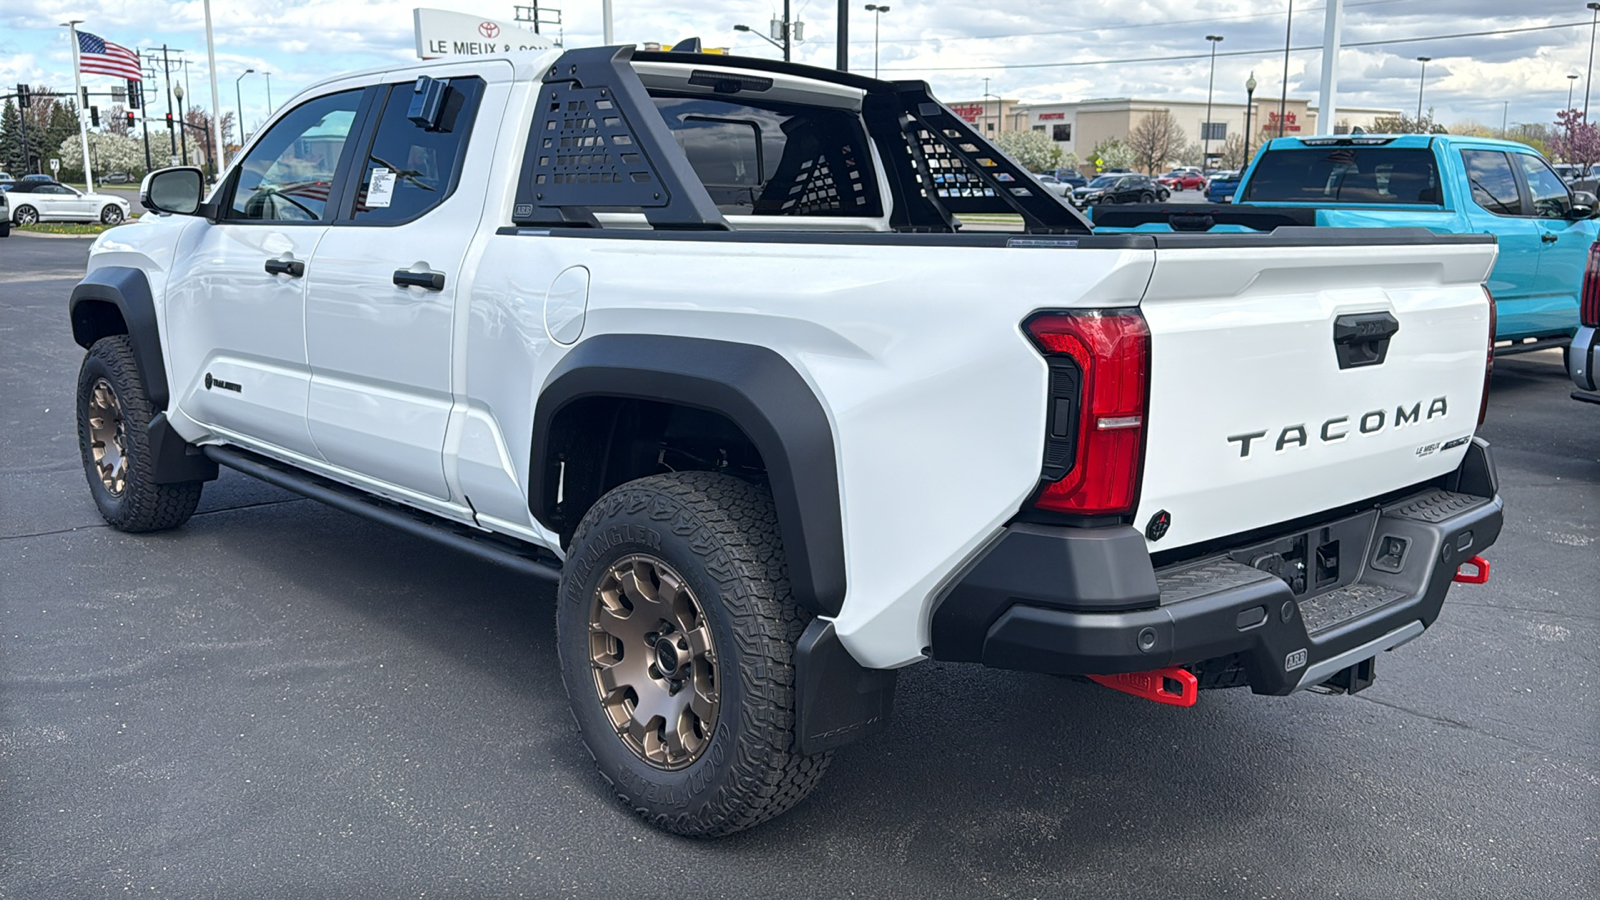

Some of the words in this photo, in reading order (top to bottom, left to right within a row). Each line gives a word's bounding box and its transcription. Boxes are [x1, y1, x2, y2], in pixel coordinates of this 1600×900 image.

[429, 40, 447, 54] LE
[453, 42, 496, 55] MIEUX
[1227, 396, 1448, 458] TACOMA
[566, 523, 662, 605] WRANGLER
[1287, 651, 1305, 668] ARB
